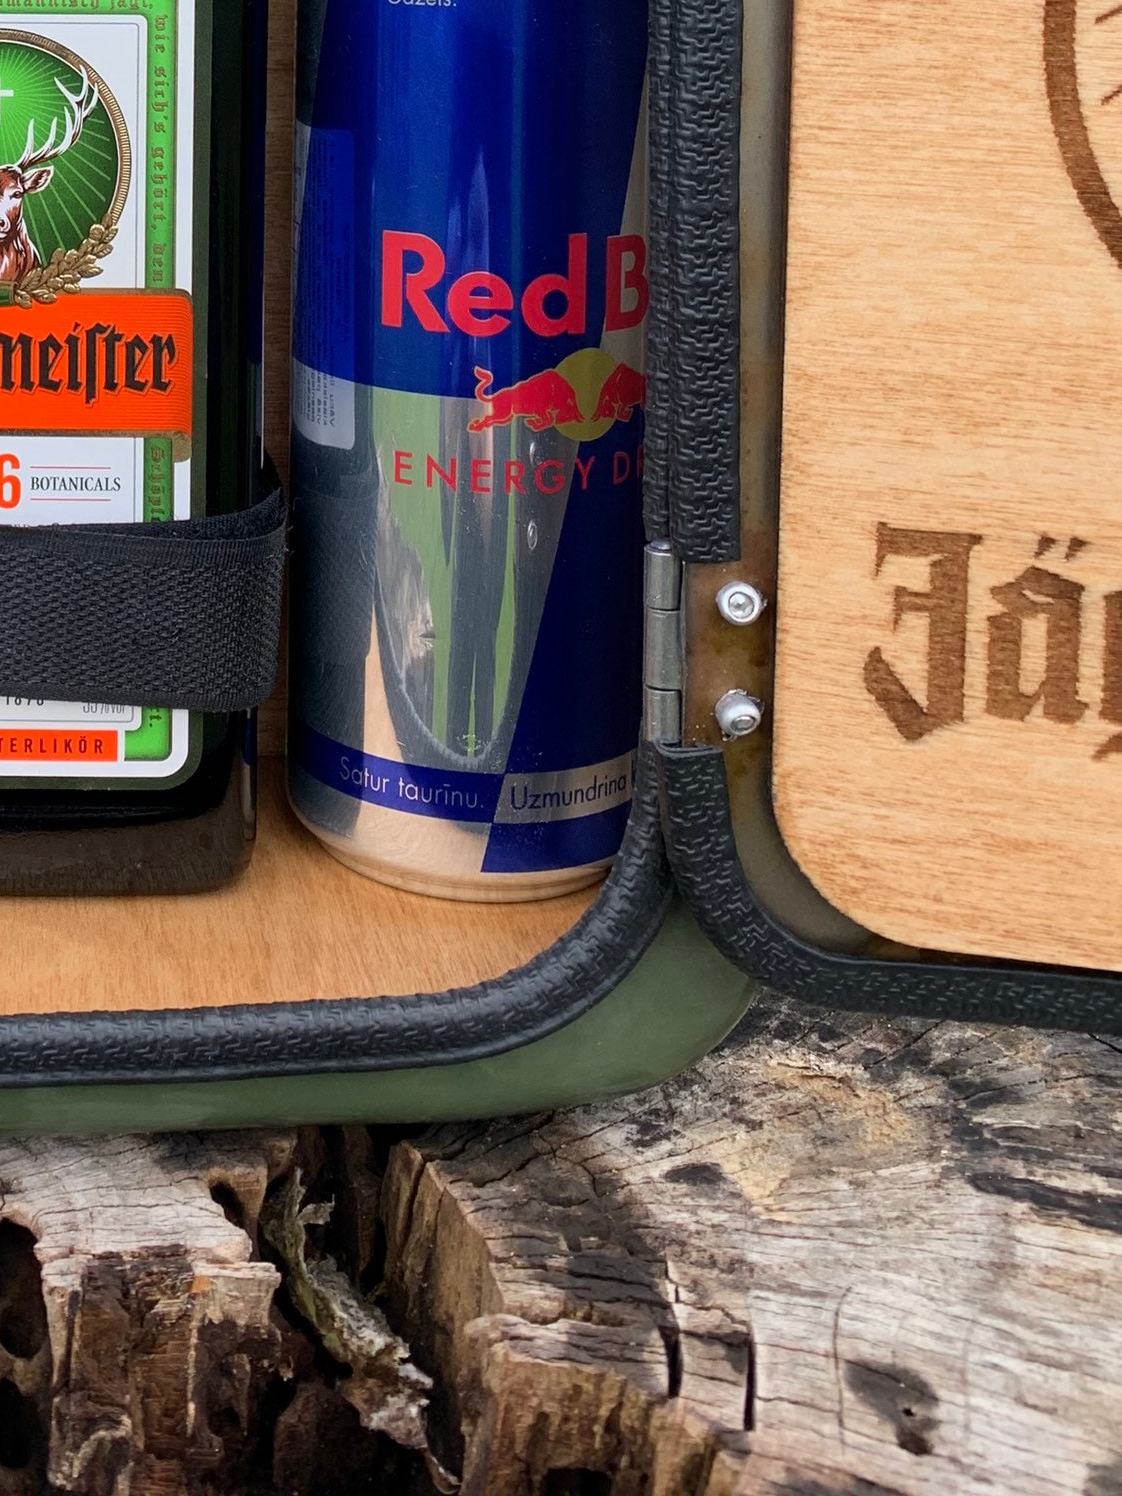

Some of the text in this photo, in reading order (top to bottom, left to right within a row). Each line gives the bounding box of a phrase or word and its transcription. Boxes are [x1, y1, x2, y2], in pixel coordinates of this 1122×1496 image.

[154, 14, 168, 53] wie
[152, 242, 167, 282] den
[381, 229, 650, 337] Red B
[30, 476, 121, 492] BOTANICALS
[394, 448, 595, 494] ENERGY
[340, 756, 484, 809] Satur taurīnu.
[510, 774, 627, 811] Uzmundrina
